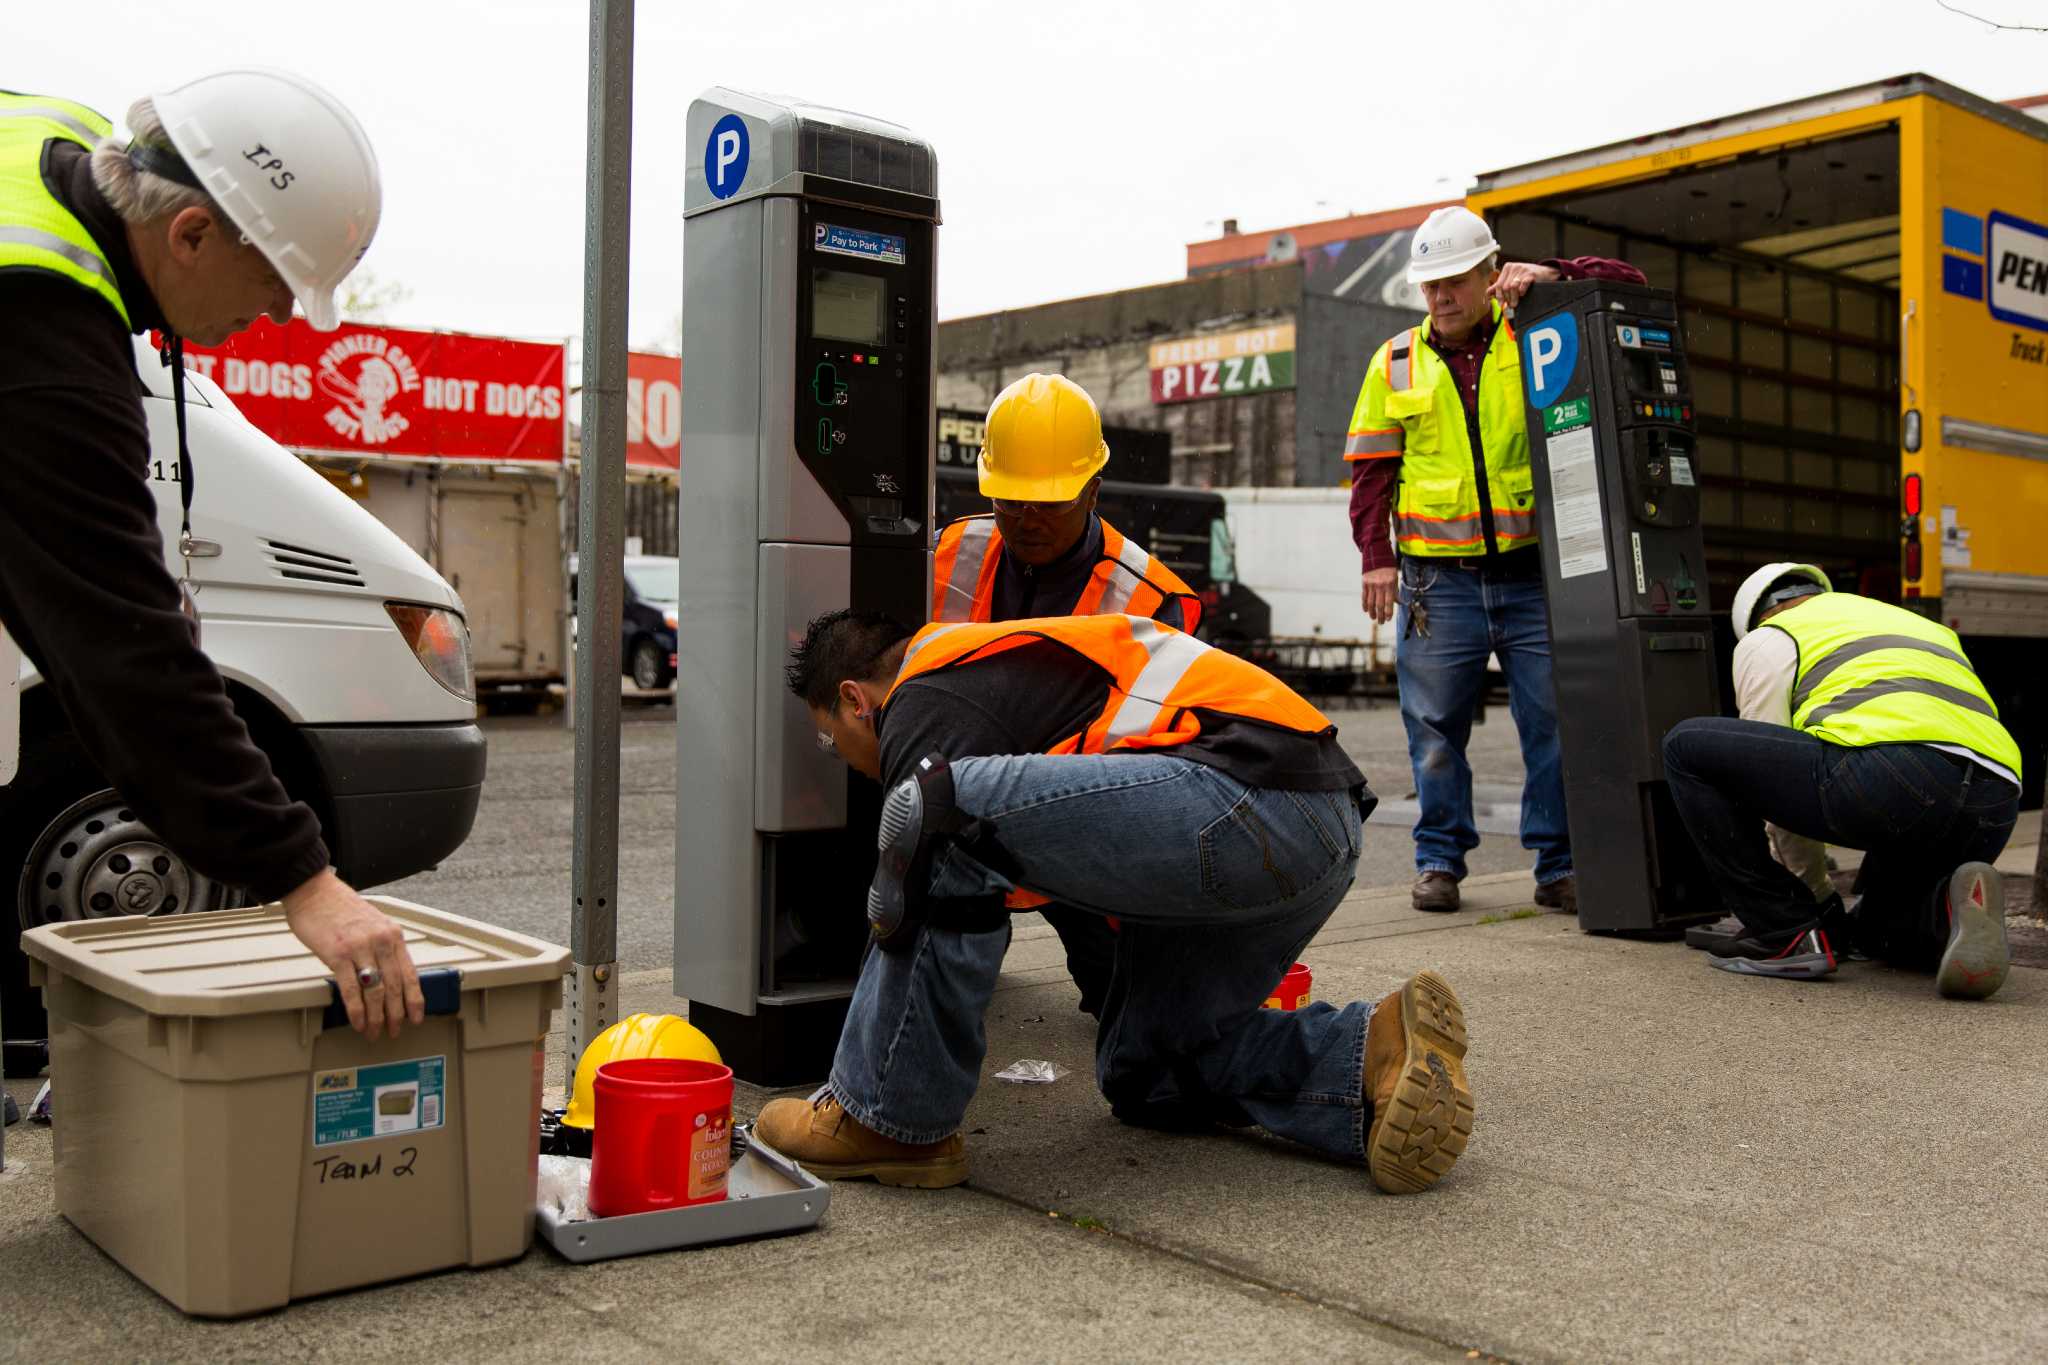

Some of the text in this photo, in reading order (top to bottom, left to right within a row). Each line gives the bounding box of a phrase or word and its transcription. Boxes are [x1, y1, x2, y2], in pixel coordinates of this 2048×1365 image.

[243, 143, 295, 190] IPS
[717, 130, 740, 186] P
[831, 235, 847, 248] Pay
[848, 237, 858, 248] to
[859, 240, 879, 252] Park
[223, 357, 313, 400] DOGS
[1162, 354, 1273, 399] PIZZA
[1529, 327, 1562, 392] P
[423, 376, 561, 420] HOT DOGS
[1553, 406, 1566, 425] 2
[392, 1147, 417, 1177] 2
